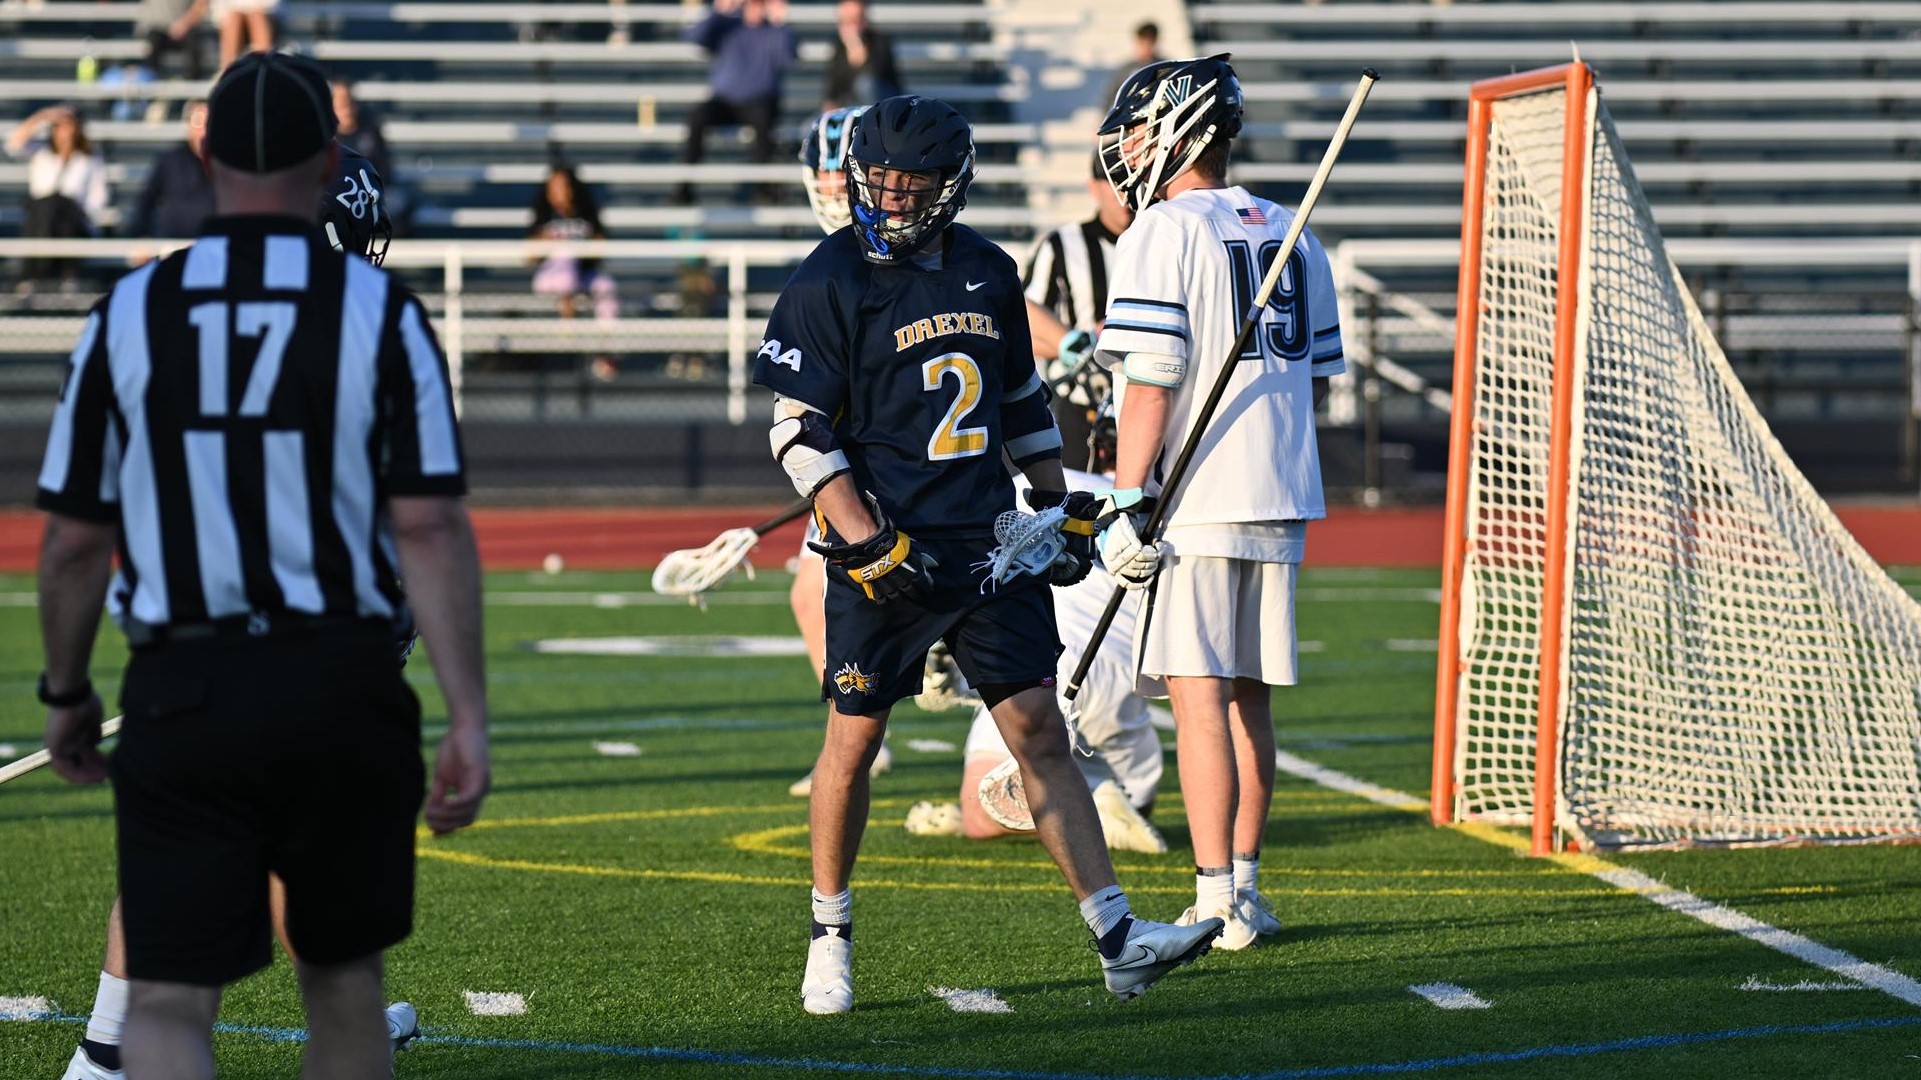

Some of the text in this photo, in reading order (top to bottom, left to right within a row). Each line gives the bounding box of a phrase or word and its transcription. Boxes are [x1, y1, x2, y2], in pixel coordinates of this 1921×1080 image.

[336, 175, 369, 219] 28
[1222, 239, 1311, 361] 19
[894, 312, 1000, 352] DREXEL
[188, 301, 297, 416] 17
[757, 339, 802, 373] AA
[922, 352, 989, 461] 2
[860, 553, 896, 581] STX
